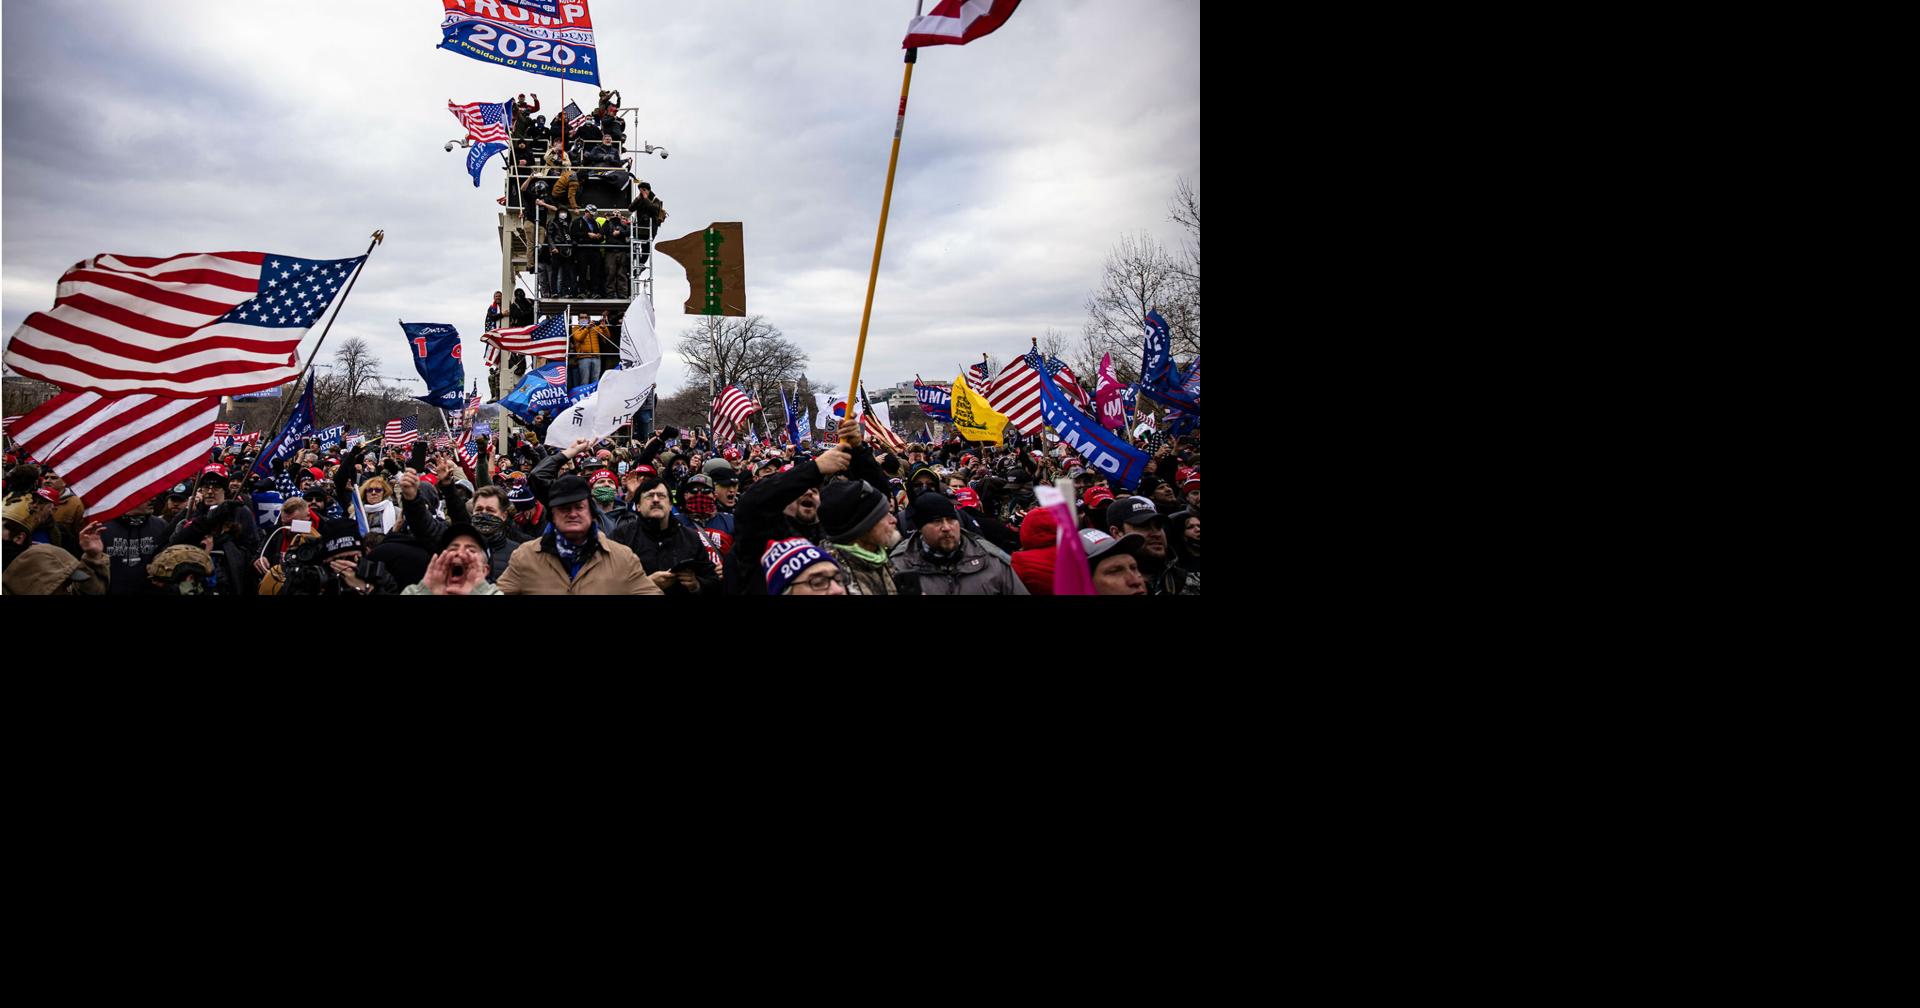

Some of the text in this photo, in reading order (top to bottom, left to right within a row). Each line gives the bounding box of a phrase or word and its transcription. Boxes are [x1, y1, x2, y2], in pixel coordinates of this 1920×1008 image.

[461, 42, 504, 63] President
[521, 61, 538, 69] The
[540, 65, 567, 73] United
[569, 68, 594, 76] States
[468, 24, 576, 66] 2020
[781, 548, 821, 579] 2016
